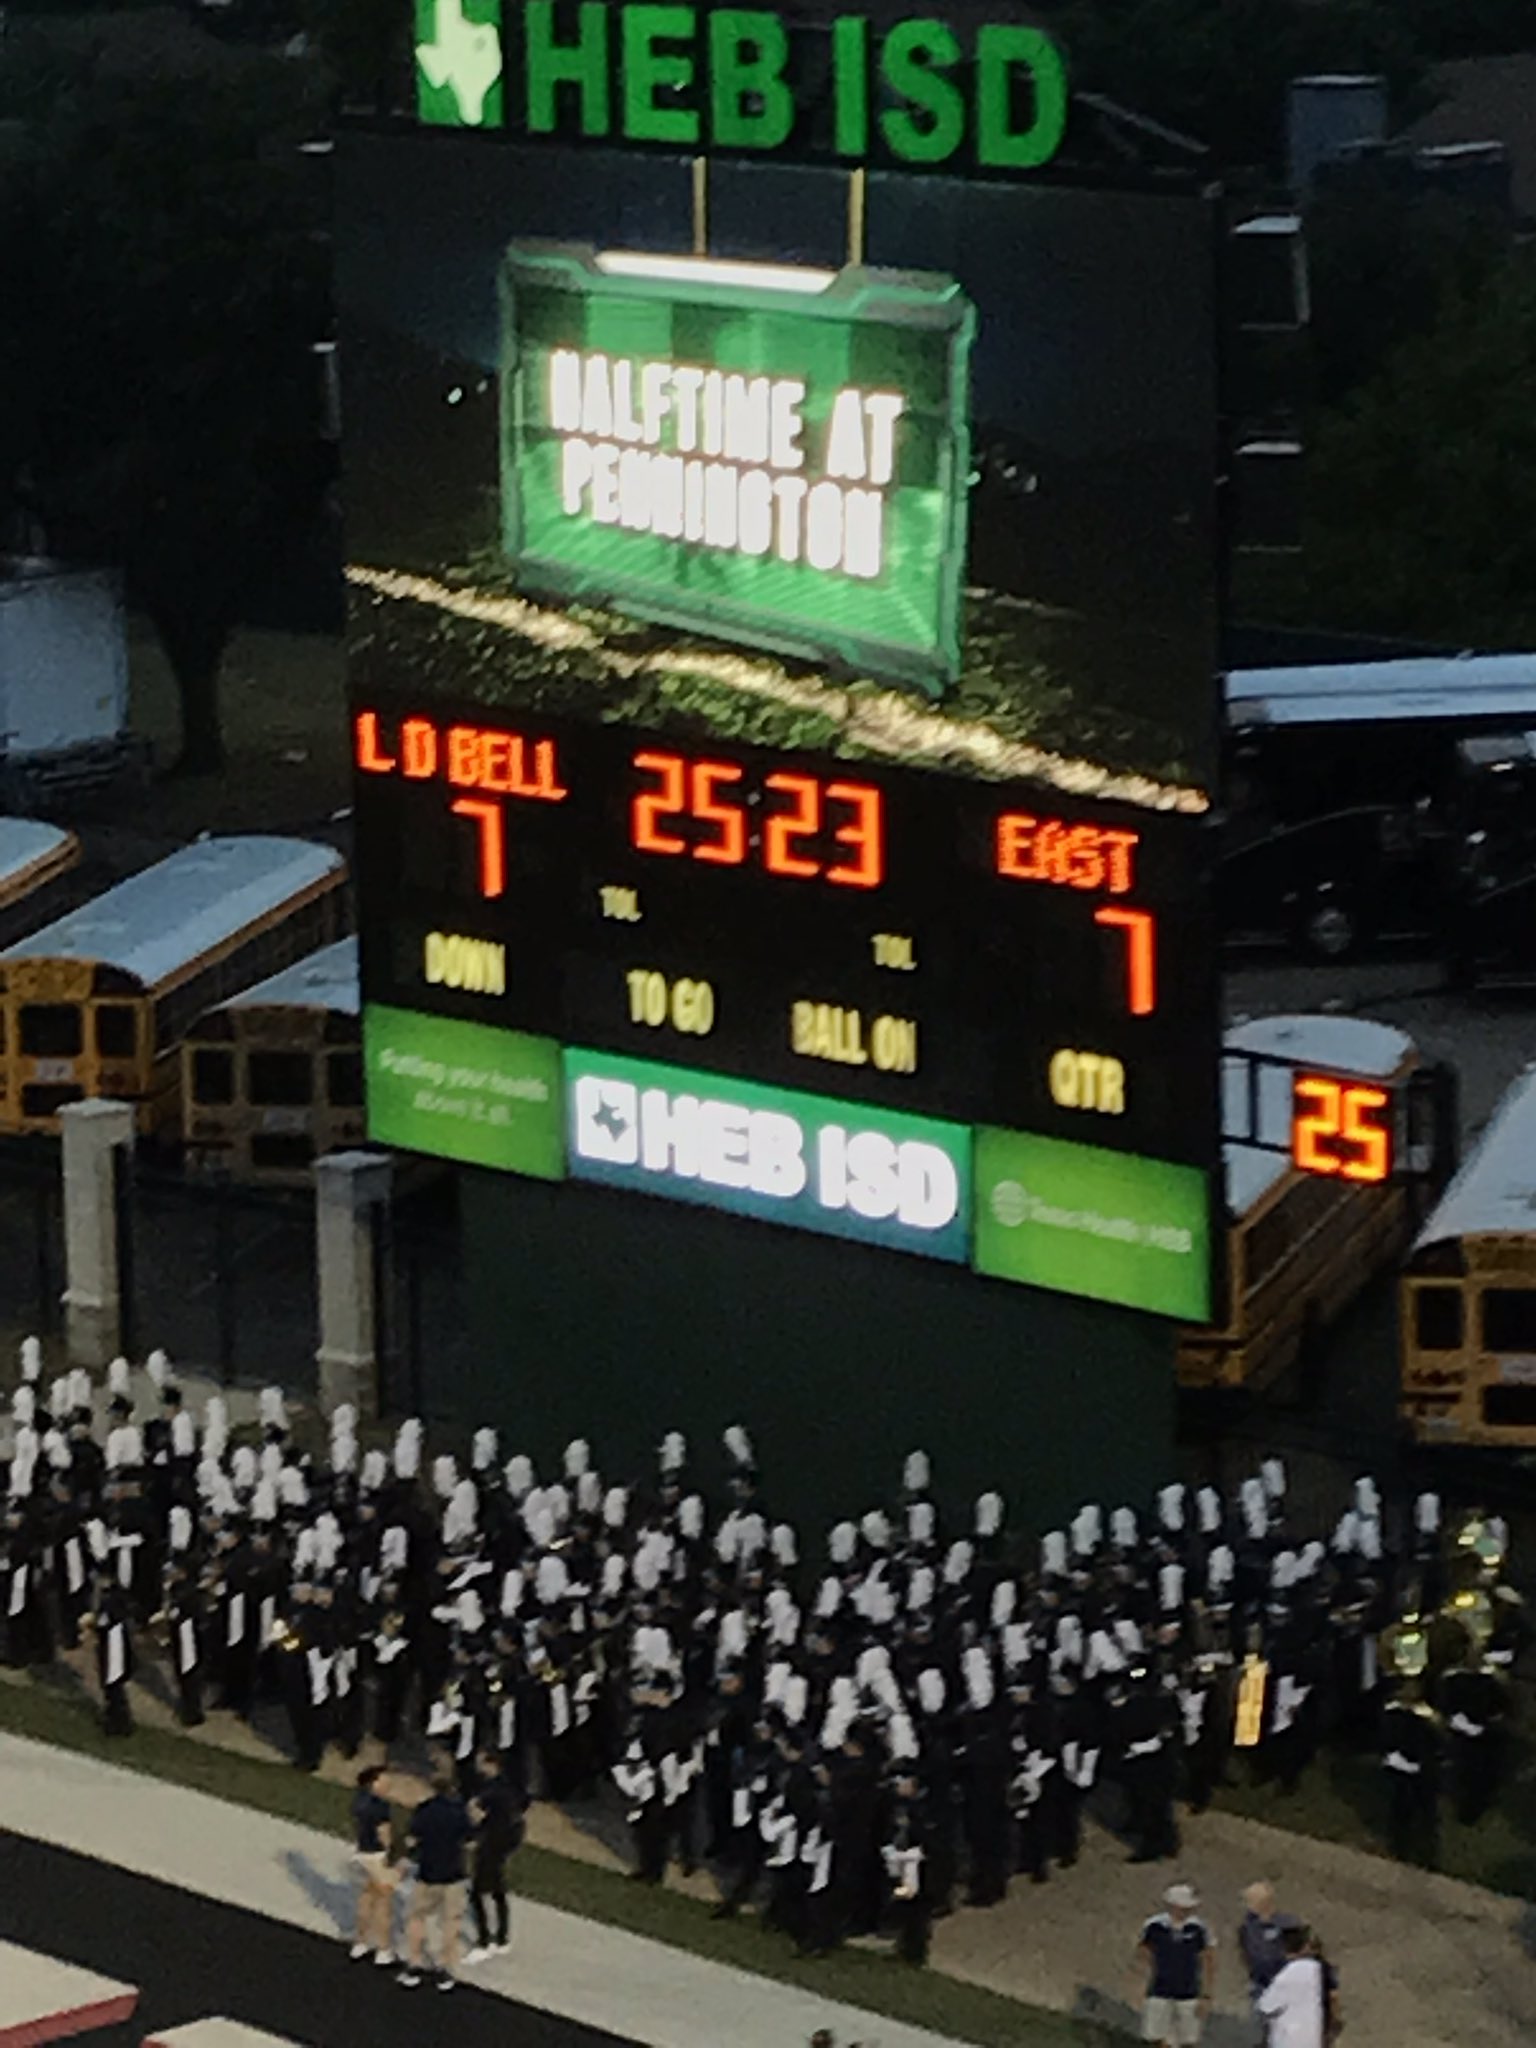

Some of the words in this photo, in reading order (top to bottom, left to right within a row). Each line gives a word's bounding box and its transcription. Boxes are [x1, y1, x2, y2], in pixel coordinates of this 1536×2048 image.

[526, 0, 796, 149] HEB
[832, 15, 1067, 168] ISD
[550, 347, 806, 470] HALFTIME
[827, 388, 904, 485] AT
[562, 436, 884, 579] PENNINGTON
[357, 712, 396, 772] L
[449, 727, 568, 799] BELL
[451, 799, 503, 898] 7
[998, 815, 1139, 892] EAST
[424, 931, 506, 996] DOWN
[626, 969, 667, 1027] TO
[671, 977, 715, 1035] GO
[1094, 908, 1154, 1014] 7
[792, 1000, 868, 1066] BALL
[872, 1014, 918, 1074] ON
[1049, 1049, 1126, 1116] QTR
[640, 1088, 808, 1198] HEB
[817, 1125, 959, 1229] ISD
[1295, 1078, 1389, 1180] 25
